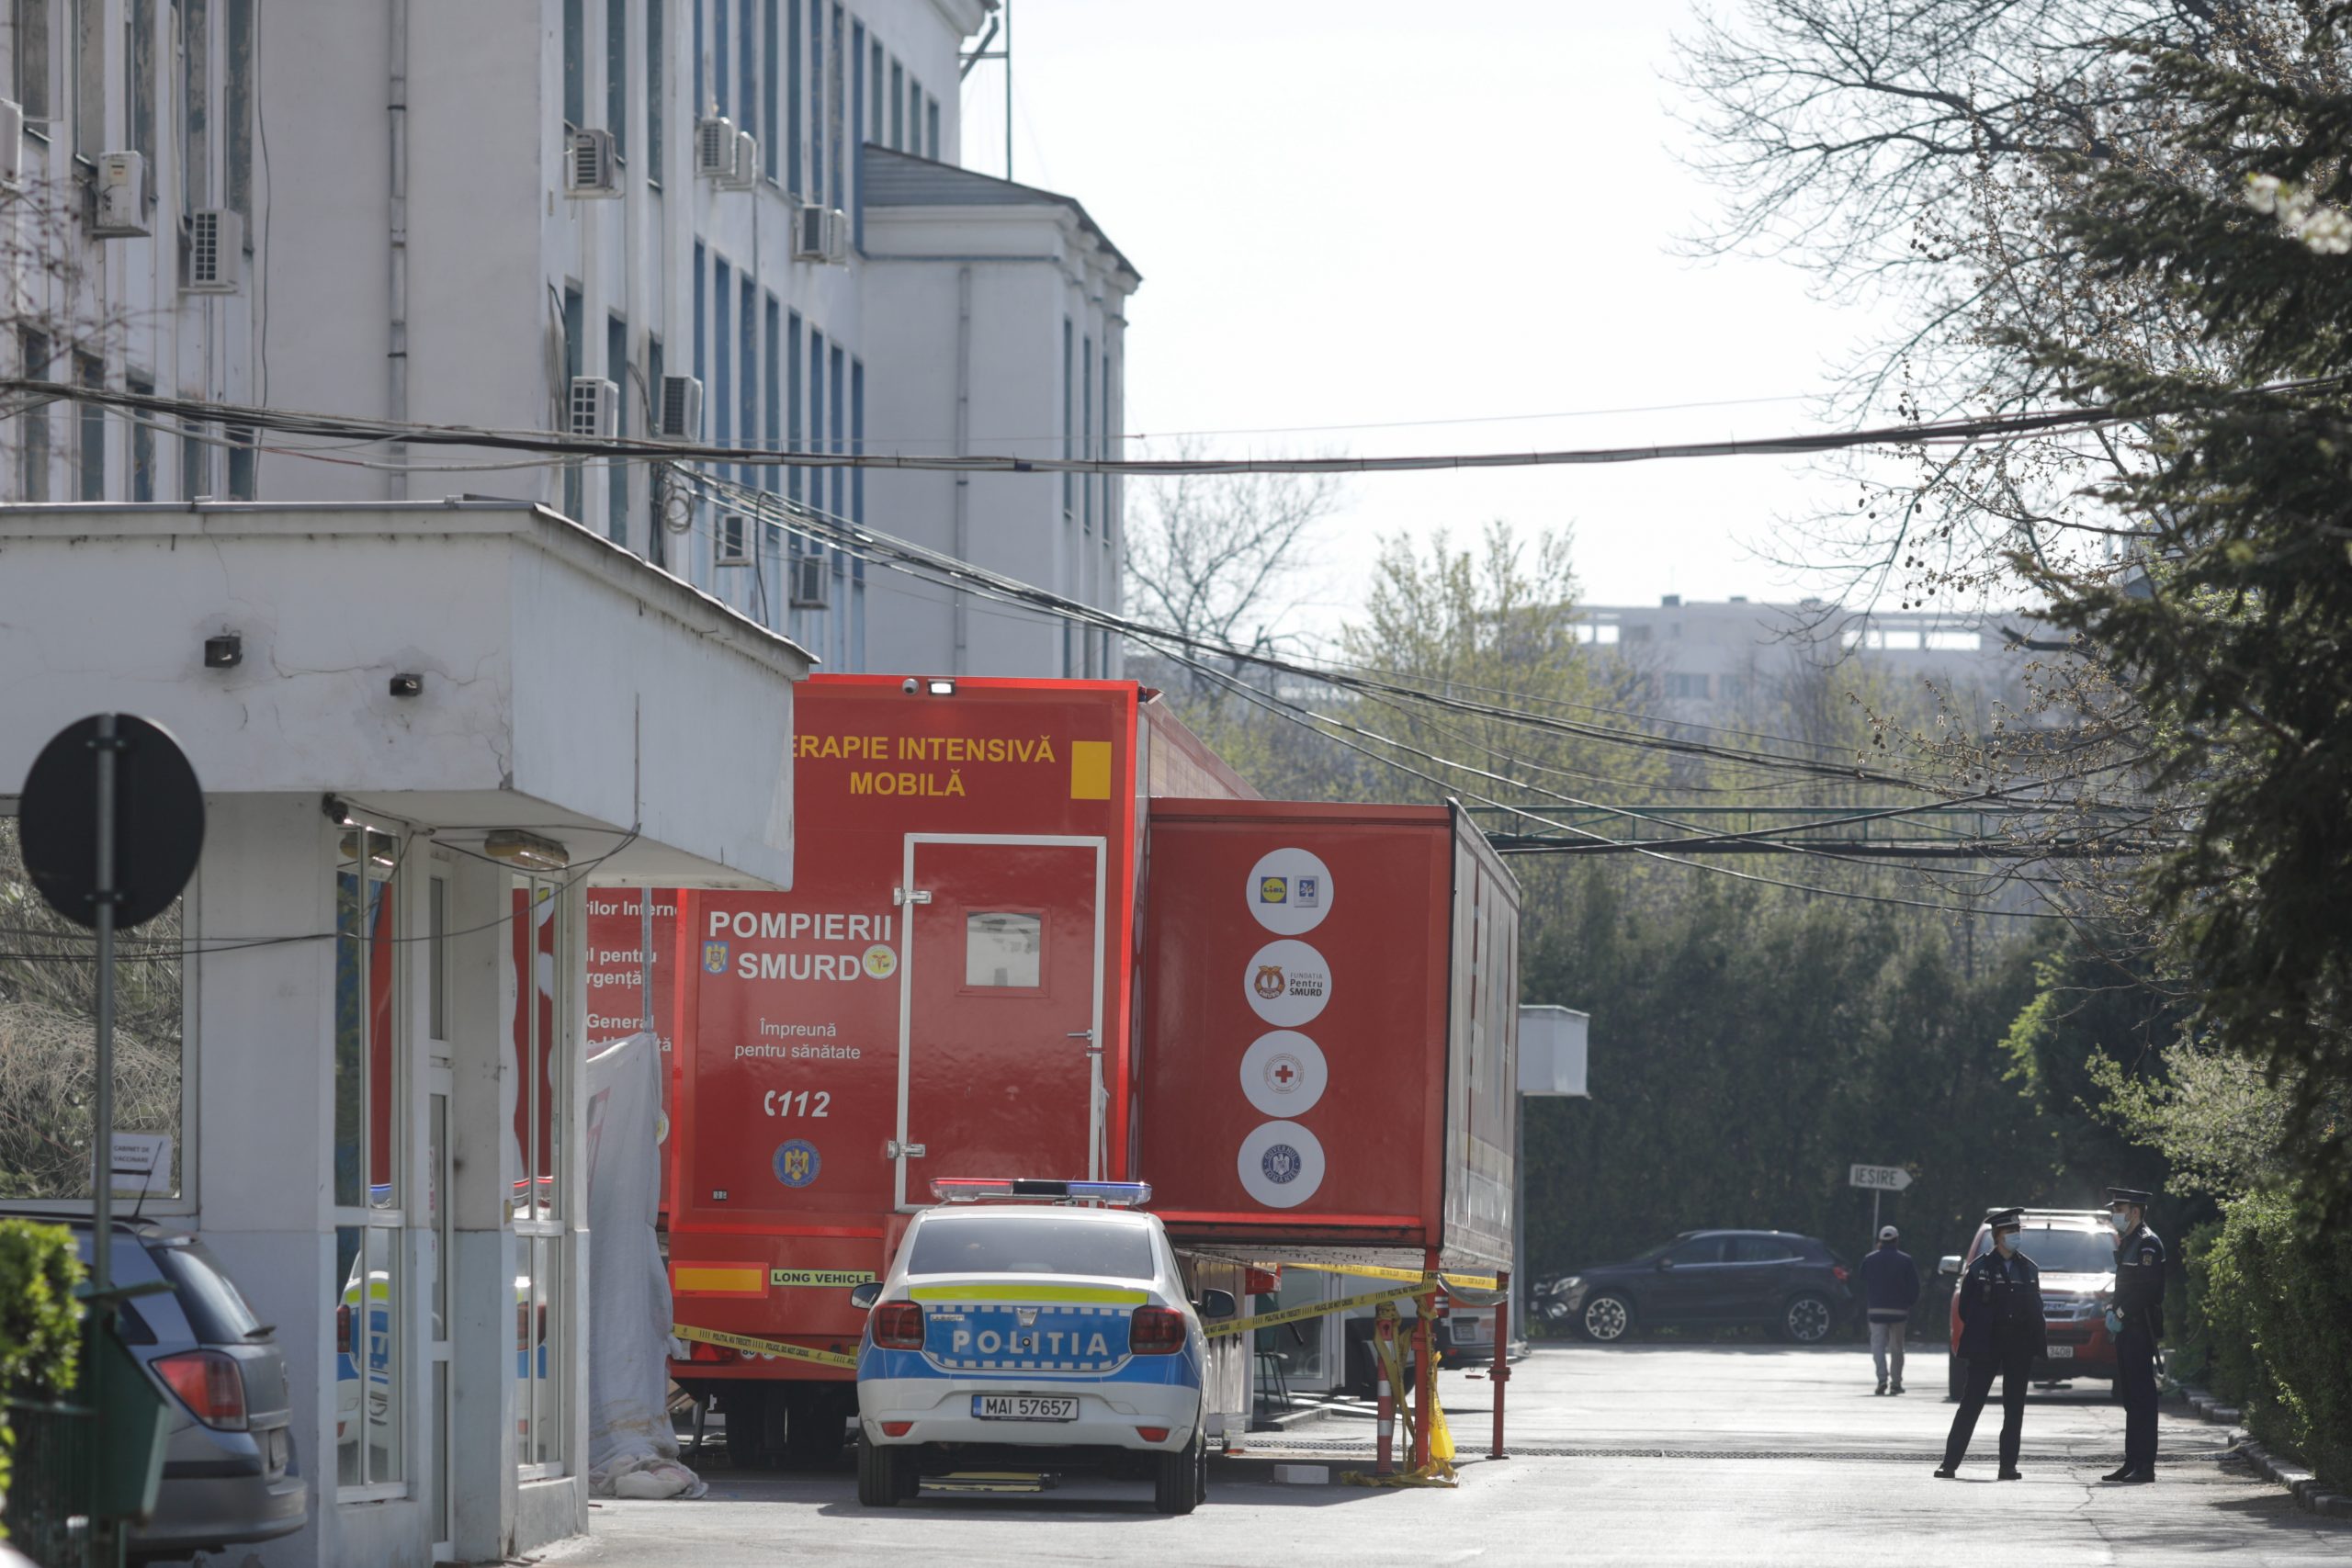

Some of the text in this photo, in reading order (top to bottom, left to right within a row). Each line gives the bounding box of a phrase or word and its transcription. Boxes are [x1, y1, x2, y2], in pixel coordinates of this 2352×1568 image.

[899, 734, 1056, 762] INTENSIVĂ
[850, 769, 966, 796] MOBILĂ
[708, 910, 892, 942] POMPIERII
[737, 952, 861, 982] SMURD
[1289, 987, 1322, 997] SMURD
[1290, 978, 1323, 987] Pentru
[760, 1018, 837, 1039] Împreună
[734, 1043, 861, 1059] pentru sănătate
[777, 1090, 831, 1118] 112
[774, 1272, 873, 1283] LONG VEHICLE
[952, 1330, 1109, 1356] POLITIA
[986, 1398, 1072, 1416] MAI 57657
